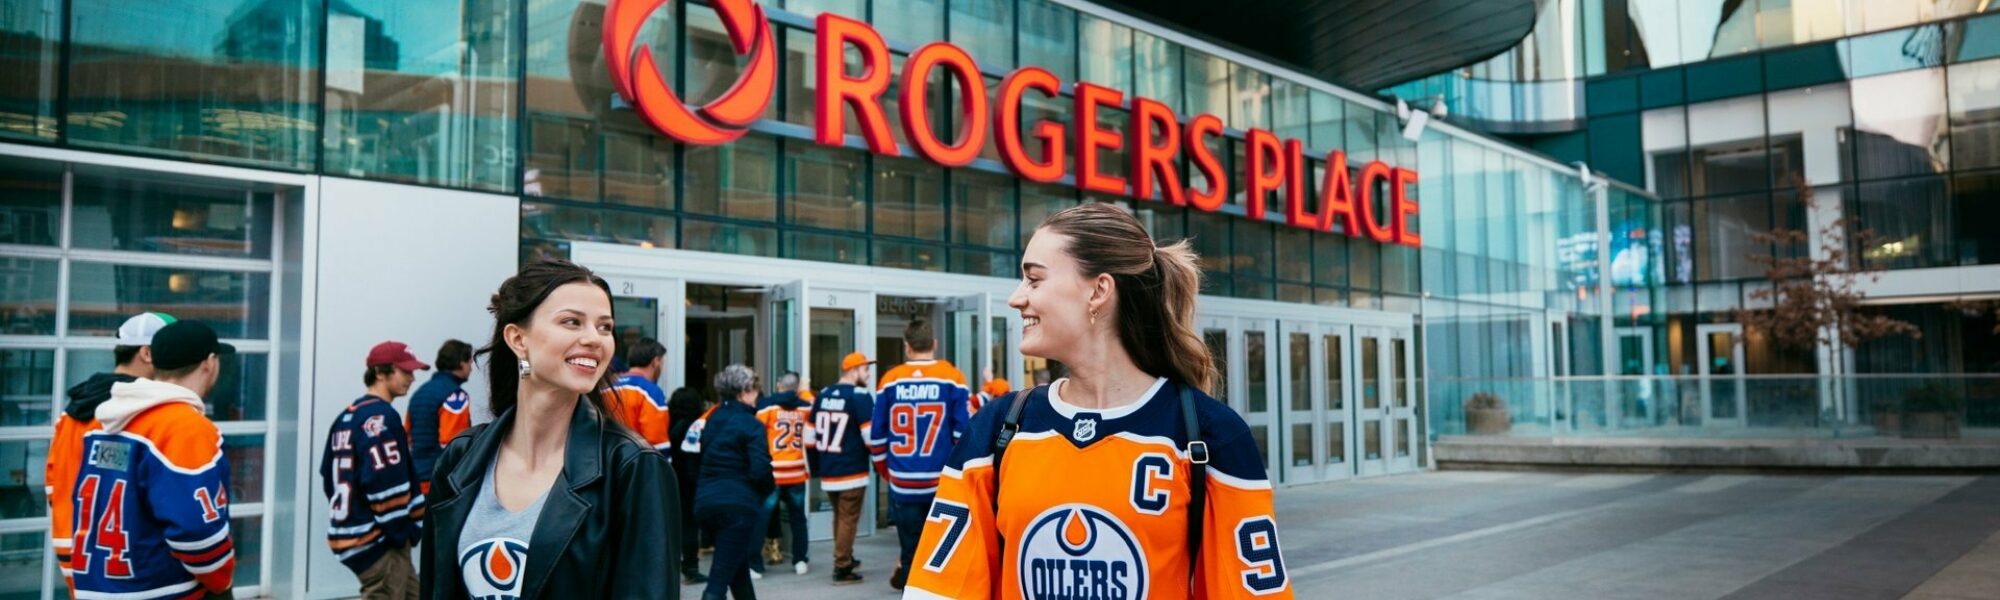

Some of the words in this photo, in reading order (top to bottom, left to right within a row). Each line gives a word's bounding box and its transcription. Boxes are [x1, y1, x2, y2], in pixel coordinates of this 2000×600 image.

[814, 12, 1228, 211] ROGERS
[1245, 128, 1421, 247] PLACE
[896, 384, 939, 400] McDAVID
[369, 441, 401, 470] 15
[815, 411, 849, 453] 97
[890, 402, 946, 457] 97
[193, 480, 228, 523] 14
[1130, 452, 1174, 516] C
[72, 474, 135, 579] 14
[924, 498, 973, 573] 7
[1031, 558, 1128, 600] OILERS
[1234, 514, 1289, 597] 9
